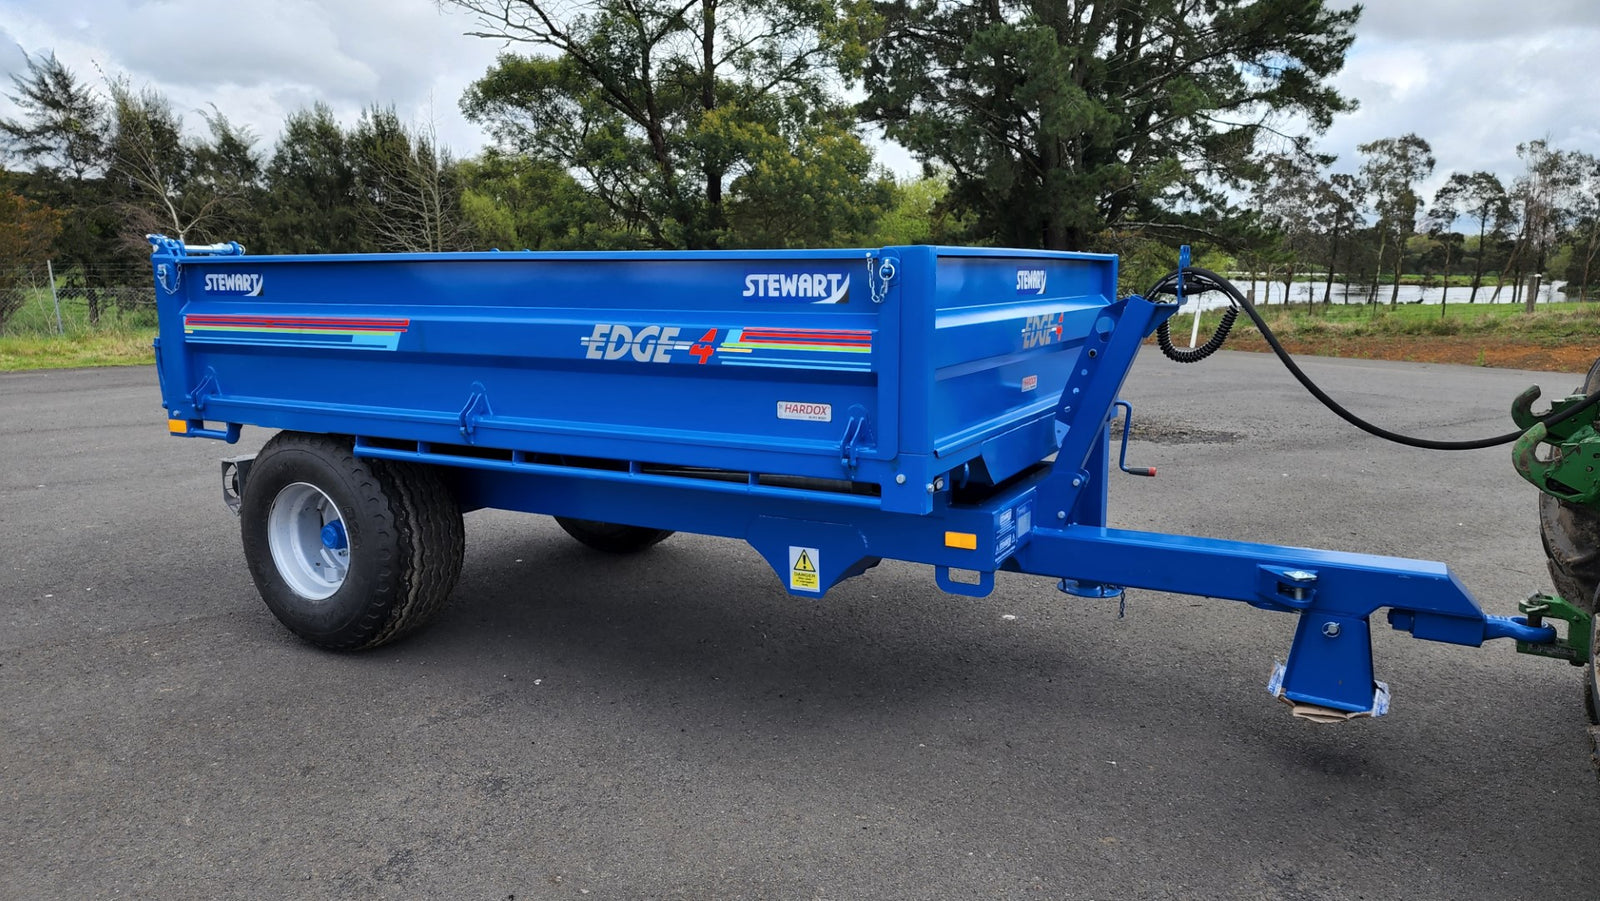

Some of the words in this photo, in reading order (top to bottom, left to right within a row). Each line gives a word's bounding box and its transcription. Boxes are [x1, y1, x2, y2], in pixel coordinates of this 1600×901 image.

[205, 273, 263, 296] STEWART
[743, 273, 849, 304] STEWART
[1016, 270, 1046, 294] STEWART
[585, 324, 681, 363] EDGE
[689, 328, 718, 365] 4
[784, 403, 828, 416] HARDOX
